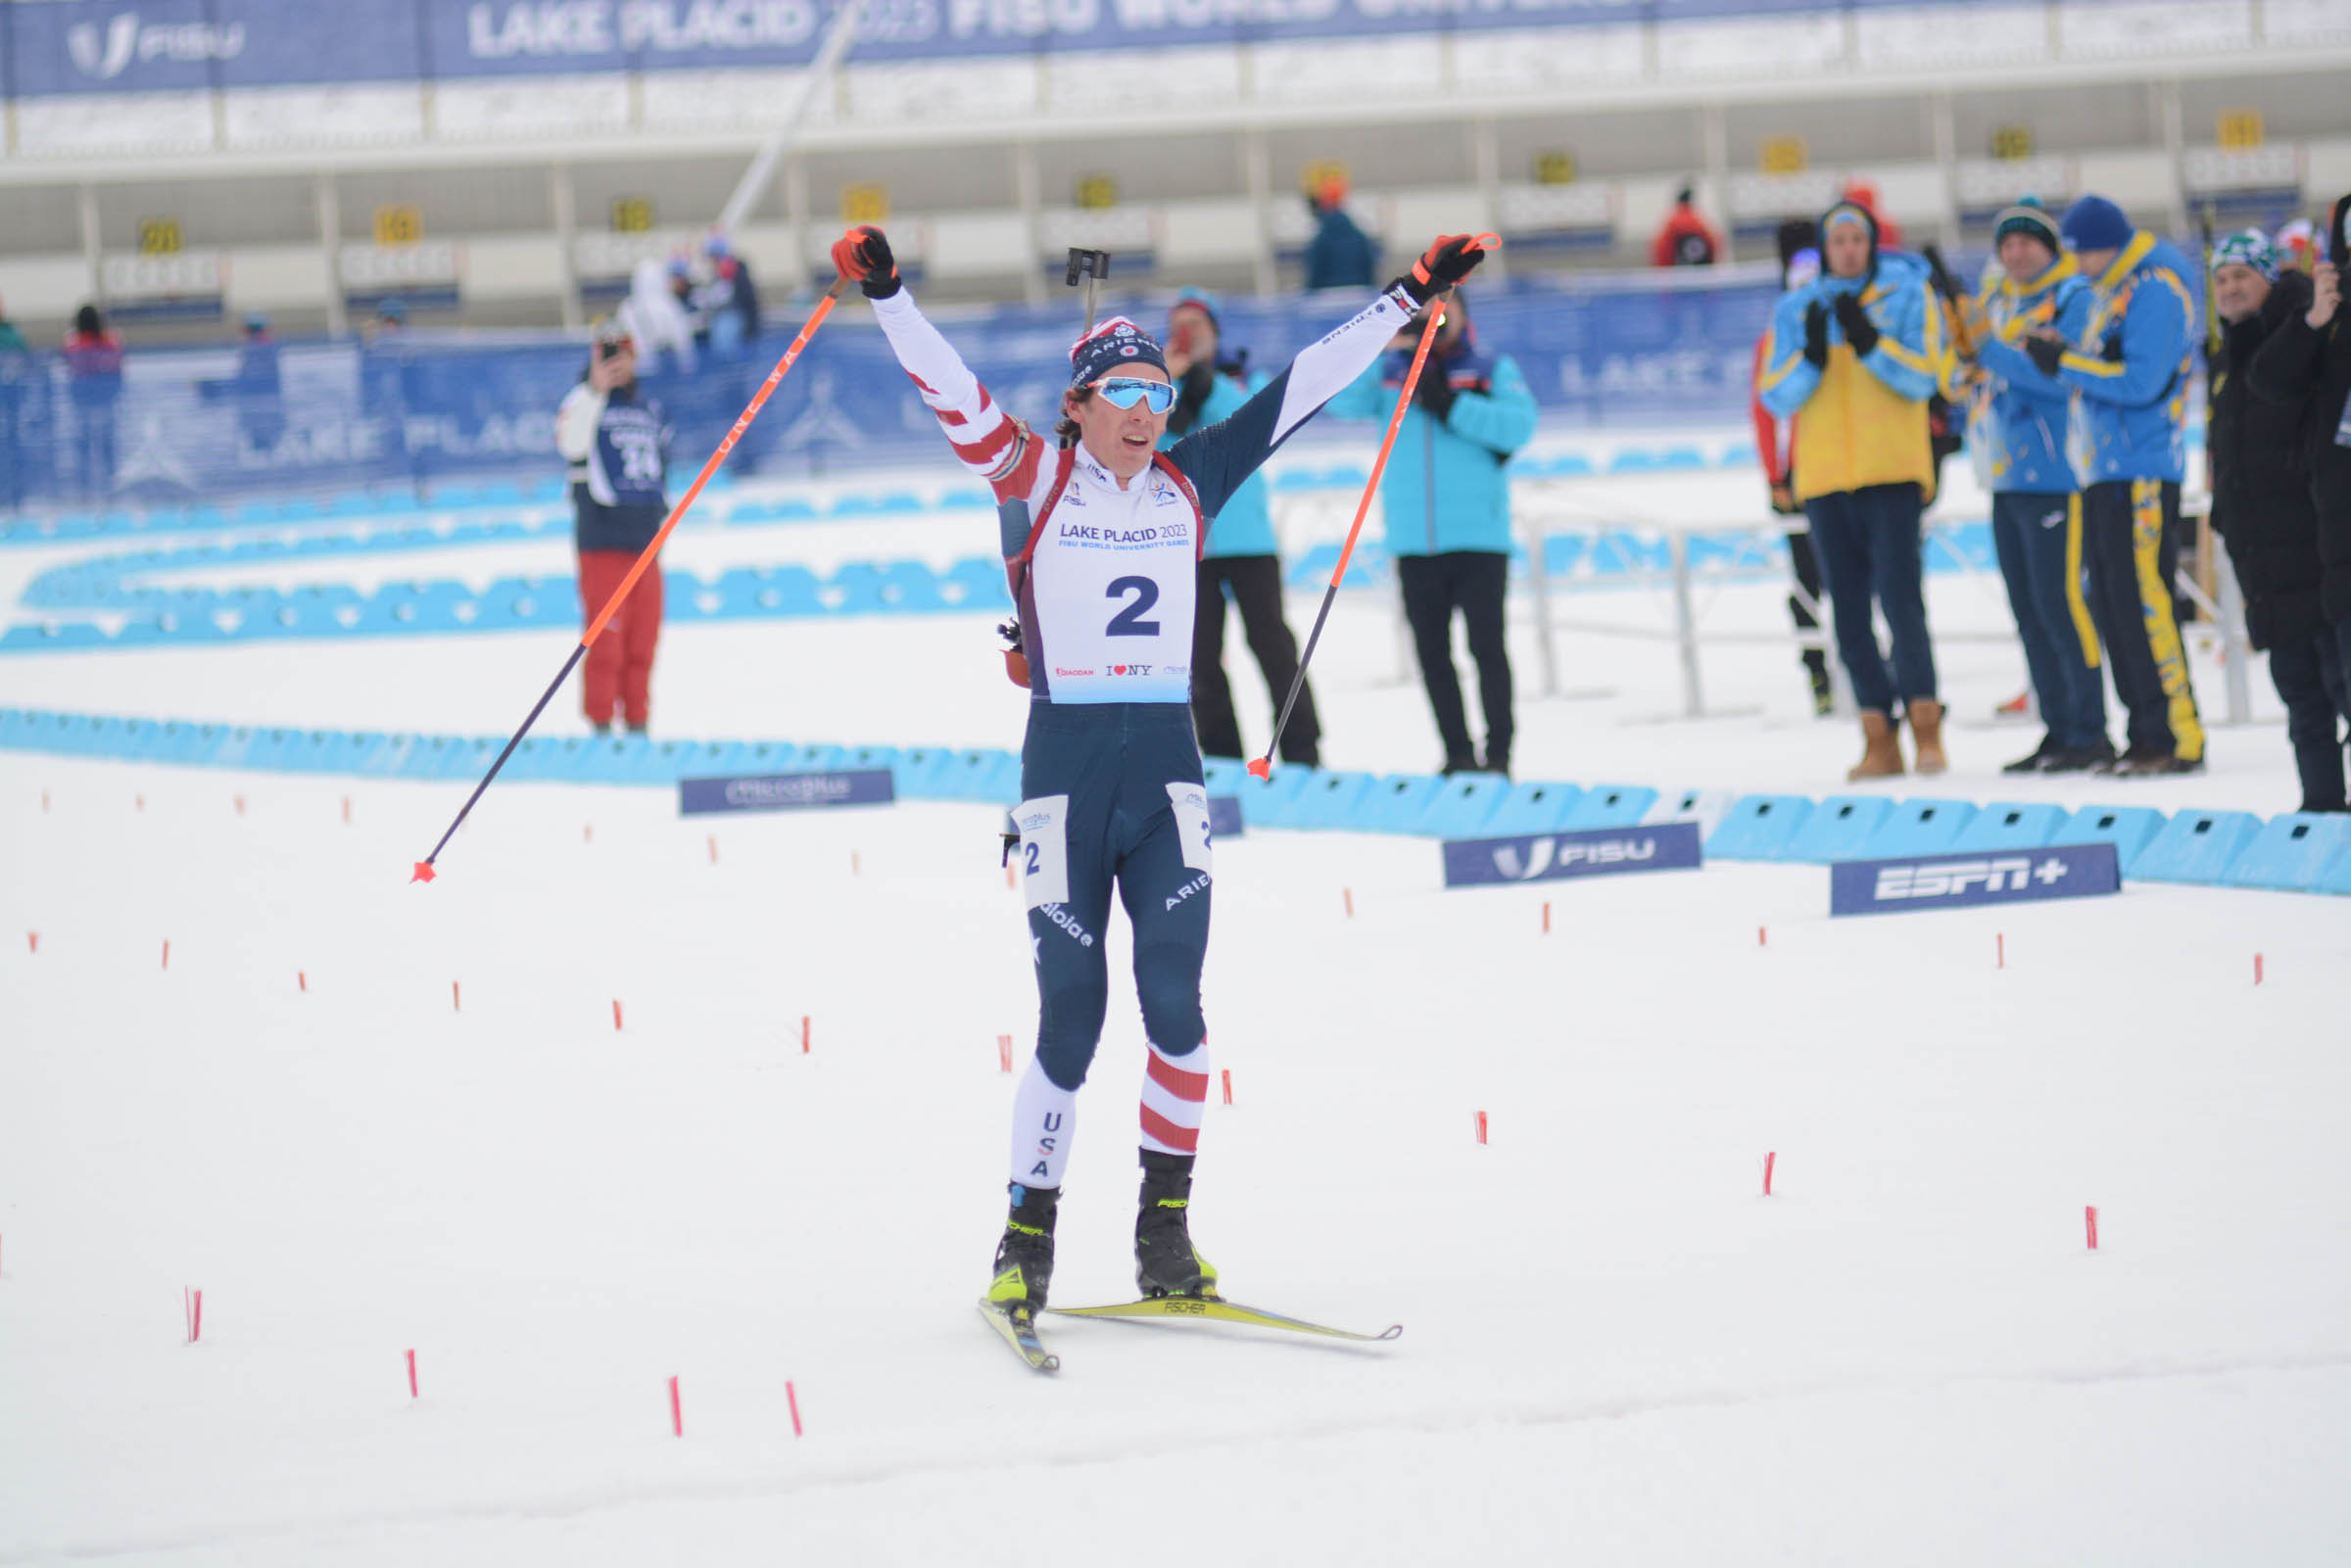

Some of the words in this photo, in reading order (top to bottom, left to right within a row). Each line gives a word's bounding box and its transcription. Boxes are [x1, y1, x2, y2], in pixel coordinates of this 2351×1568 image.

[467, 4, 610, 58] LAKE
[620, 0, 816, 51] PLACID
[1060, 523, 1100, 540] LAKE
[1104, 528, 1157, 543] PLACID
[1159, 524, 1187, 538] 2023
[1080, 541, 1111, 549] WORLD
[1113, 542, 1164, 550] UNIVERSITY
[1105, 575, 1161, 638] 2
[1128, 664, 1153, 676] NY
[1025, 841, 1040, 878] 2
[1559, 836, 1656, 867] FISU
[1030, 1112, 1062, 1177] USA
[1164, 1301, 1206, 1315] FISCHER
